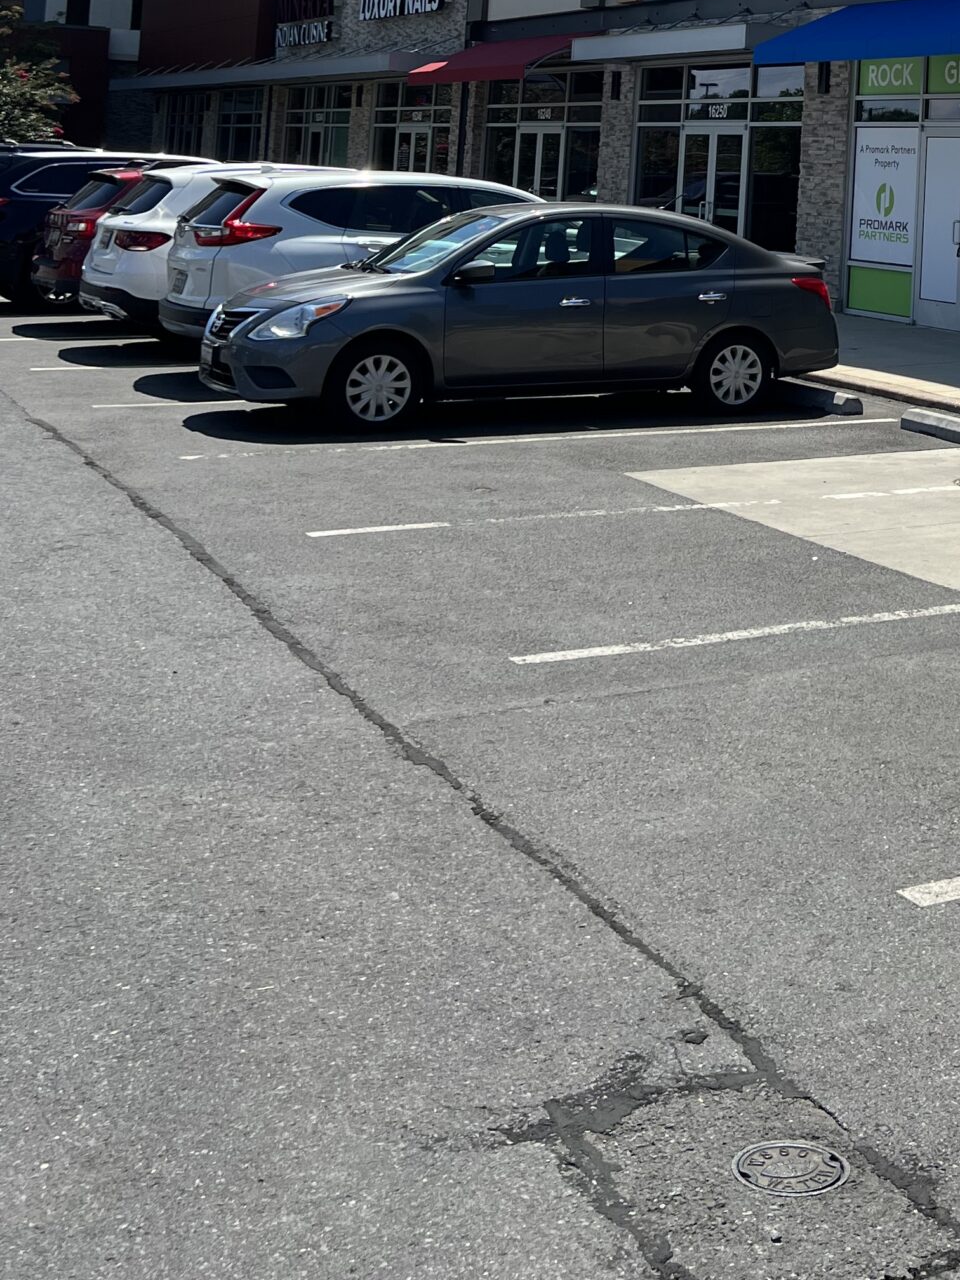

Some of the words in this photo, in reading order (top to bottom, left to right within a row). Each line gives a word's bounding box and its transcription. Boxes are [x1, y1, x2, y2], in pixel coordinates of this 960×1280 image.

[868, 63, 914, 87] ROCK
[708, 104, 728, 118] 16250
[860, 145, 865, 154] A
[866, 145, 890, 155] Promark
[890, 145, 916, 155] Partners
[874, 158, 900, 170] Property
[858, 219, 909, 232] PROMARK
[858, 229, 909, 244] PARTNERS
